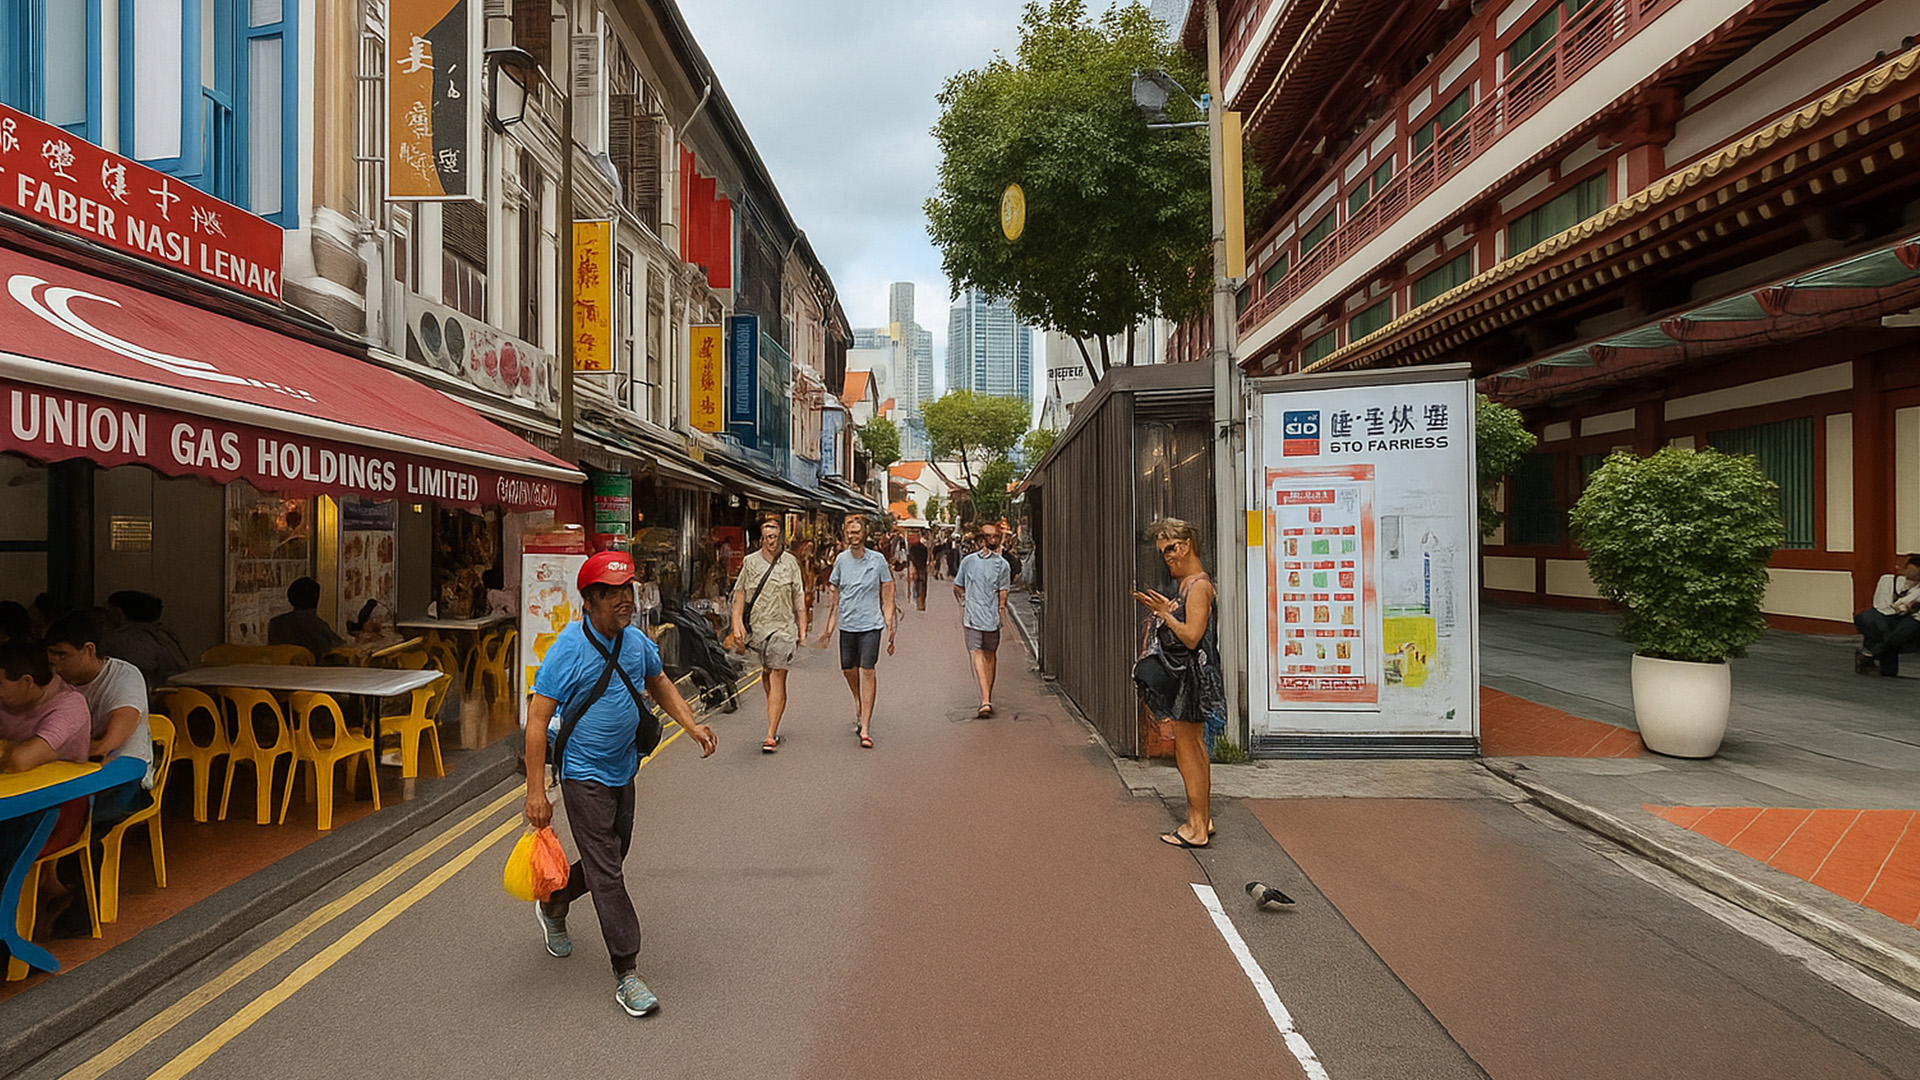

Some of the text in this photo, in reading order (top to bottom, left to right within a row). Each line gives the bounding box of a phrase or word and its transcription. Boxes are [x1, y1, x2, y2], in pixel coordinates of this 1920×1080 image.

[17, 173, 117, 240] FABER
[126, 215, 191, 267] NASI
[200, 244, 279, 298] LENAK
[10, 390, 147, 457] UNION
[170, 422, 242, 471] GAS
[257, 438, 397, 493] HOLDINGS
[407, 463, 479, 502] LIMITED
